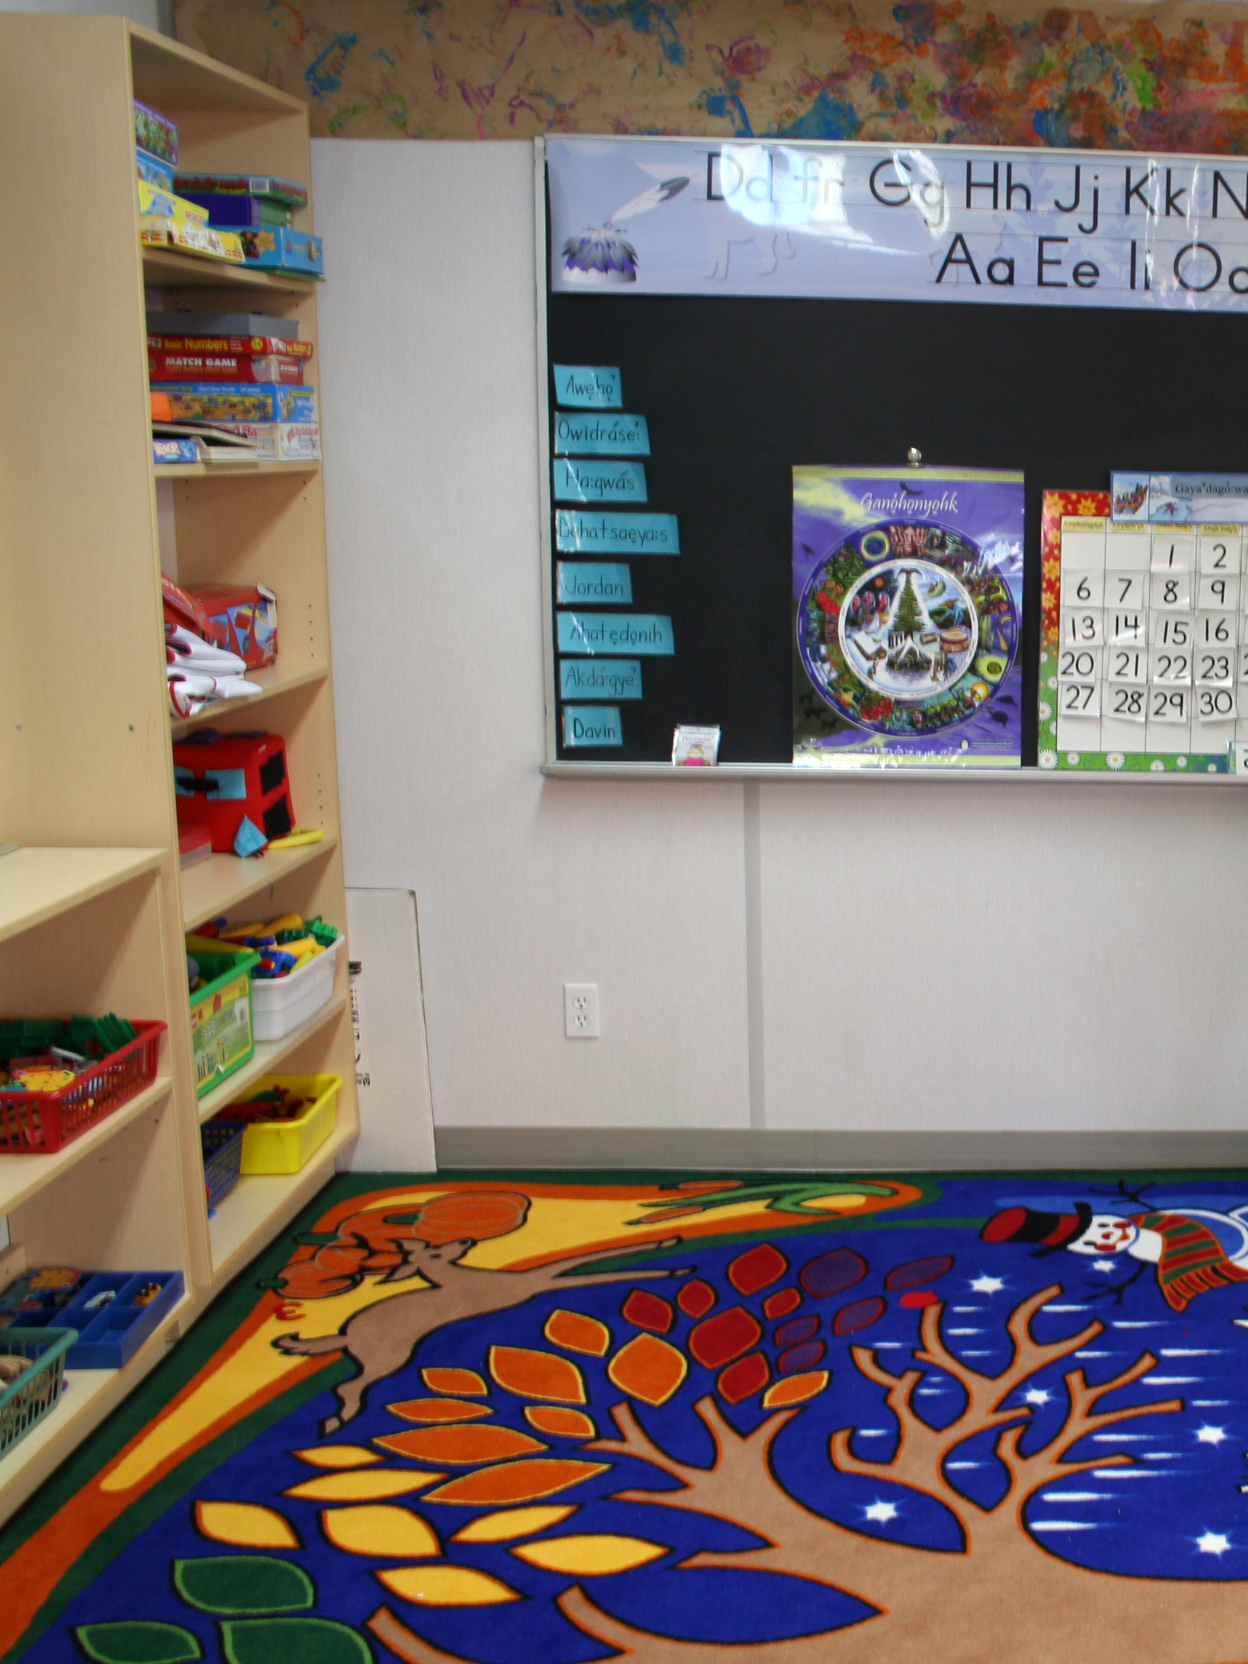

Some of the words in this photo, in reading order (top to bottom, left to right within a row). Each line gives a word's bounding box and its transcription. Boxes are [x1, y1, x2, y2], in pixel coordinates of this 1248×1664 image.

[706, 152, 773, 202] Dd
[869, 158, 945, 229] Gg
[965, 160, 1032, 212] Hh
[1053, 164, 1098, 234] Jj
[1124, 166, 1186, 217] Kk
[935, 233, 1015, 285] Aa
[1038, 237, 1100, 288] Ee
[185, 338, 229, 350] Numbers
[165, 357, 203, 366] MATCH
[205, 358, 238, 367] GAME
[1169, 544, 1176, 567] 1
[1212, 544, 1227, 569] 2
[565, 574, 624, 596] Jordan
[1076, 578, 1091, 600] 6
[1119, 579, 1132, 603] 7
[1163, 580, 1179, 603] 8
[1210, 580, 1226, 604] 9
[1071, 617, 1094, 639] 13
[1115, 615, 1139, 636] 14
[1163, 620, 1187, 645] 15
[1205, 618, 1229, 642] 16
[1061, 651, 1094, 675] 20
[1115, 652, 1139, 677] 21
[1158, 655, 1187, 678] 22
[1201, 655, 1229, 679] 23
[1066, 685, 1095, 709] 27
[1113, 689, 1144, 714] 28
[1153, 692, 1184, 717] 29
[1200, 689, 1233, 715] 30
[573, 717, 617, 740] Davin
